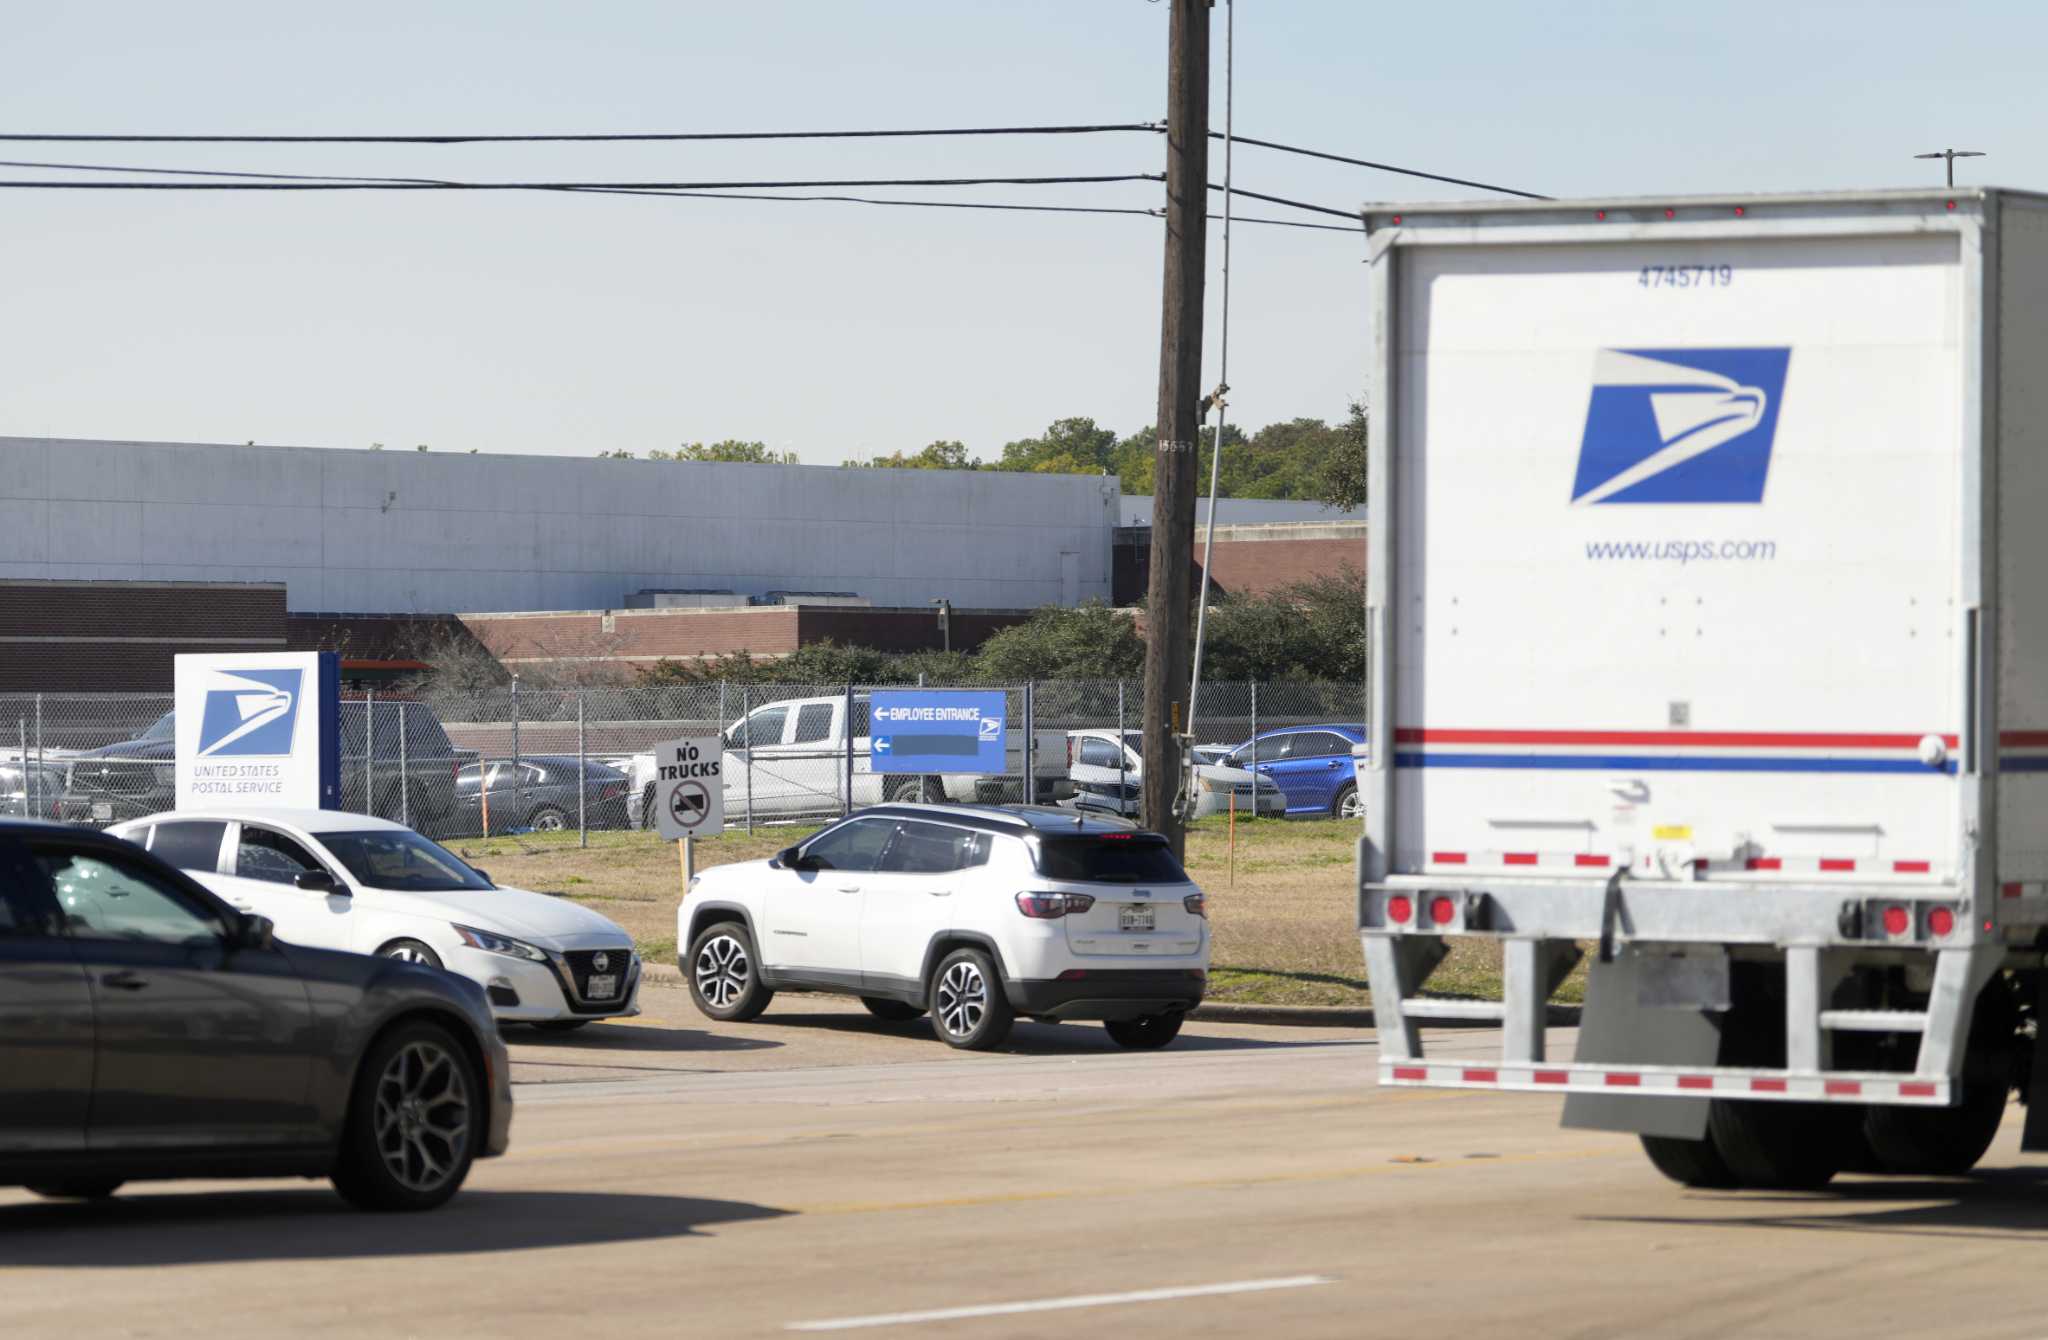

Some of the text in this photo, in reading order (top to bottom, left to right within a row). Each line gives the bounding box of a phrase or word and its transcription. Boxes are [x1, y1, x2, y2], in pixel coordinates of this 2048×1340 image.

[1638, 265, 1732, 288] 4745719
[1585, 540, 1776, 566] www.usps.com
[890, 708, 979, 720] EMPLOYEE ENTRANCE
[676, 746, 699, 762] NO
[194, 765, 279, 777] UNITED STATES
[659, 761, 720, 780] TRUCKS
[192, 782, 282, 793] POSTAL SERVICE
